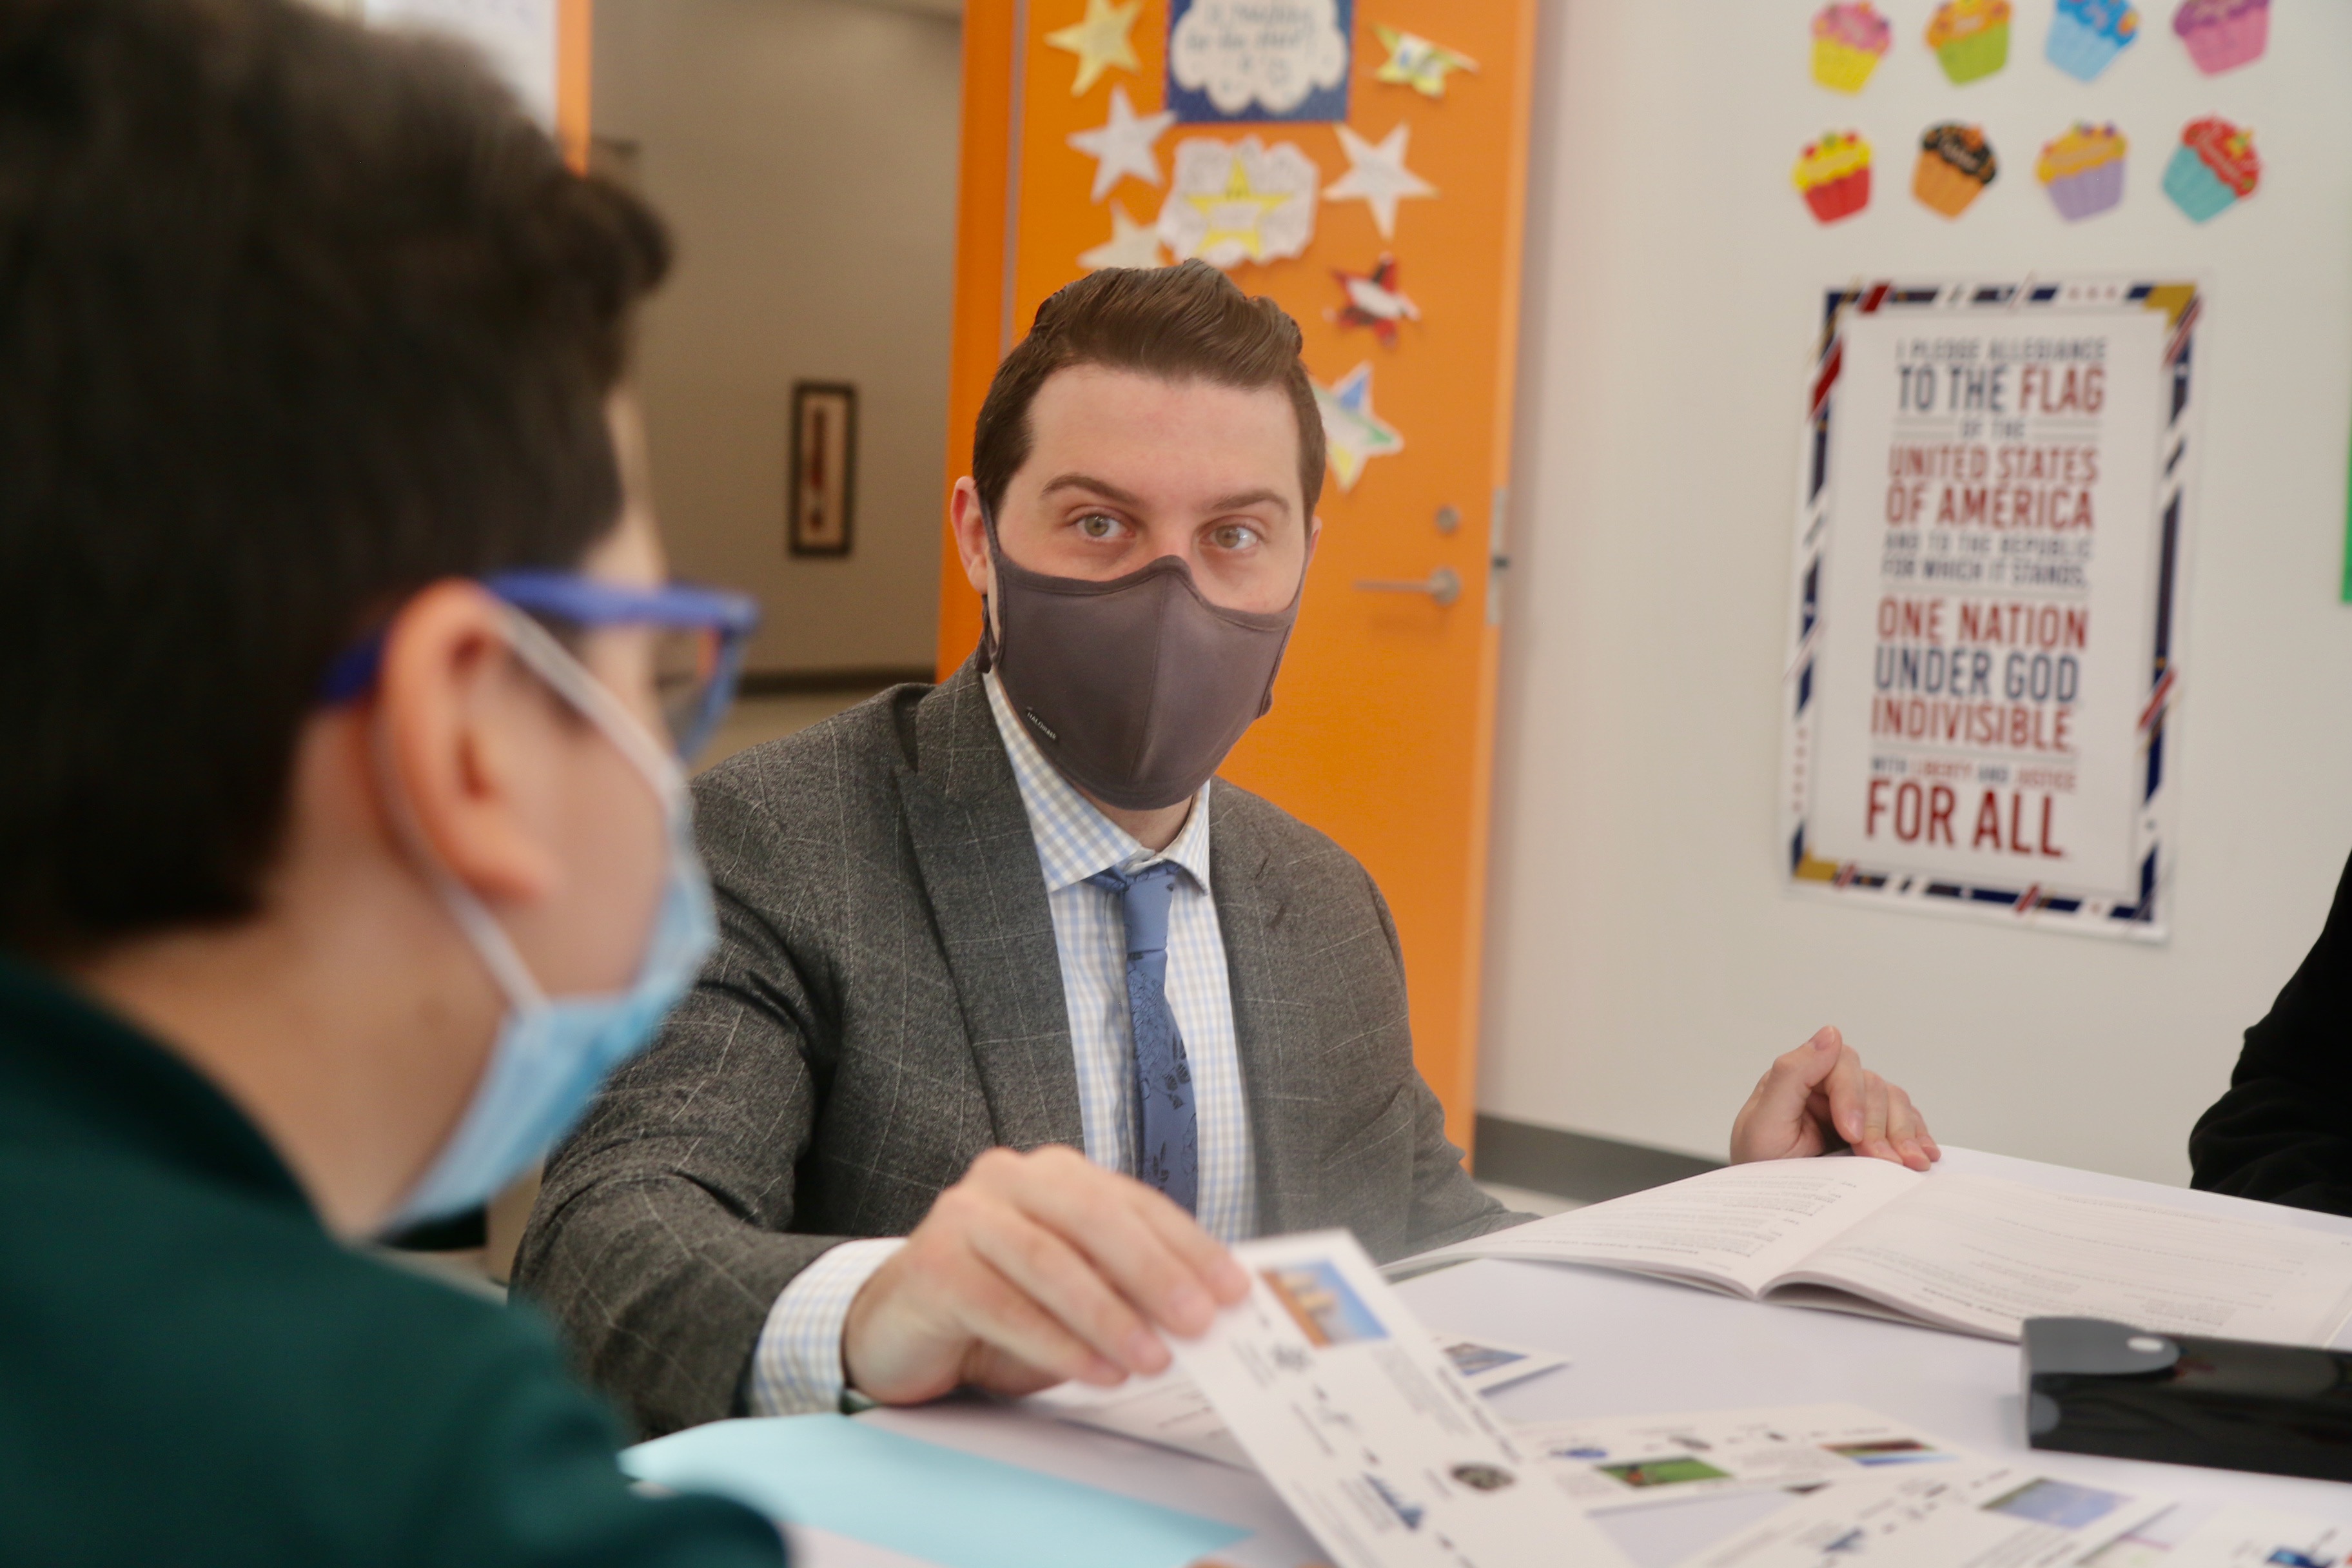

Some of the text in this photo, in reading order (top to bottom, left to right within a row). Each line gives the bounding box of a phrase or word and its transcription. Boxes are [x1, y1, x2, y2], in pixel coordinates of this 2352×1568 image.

[1910, 337, 1980, 360] PLEDGE
[1988, 336, 2108, 362] ALLEGIANCE
[1898, 362, 2106, 414] TO THE FLAG
[1961, 420, 2025, 440] OF THE
[1888, 444, 2099, 482] UNITED STATES
[1885, 482, 2093, 531] OF AMERICA
[1885, 531, 2093, 558] AND TO THE REPUBLIC
[1882, 557, 1916, 578] FOR
[1922, 559, 1983, 580] WHICH
[1990, 561, 2007, 582] IT
[1877, 596, 2090, 651] ONE NATION
[1874, 643, 2080, 704] UNDER GOD
[1872, 755, 2078, 794] WITH LIBERTY AND JUSTICE
[1866, 778, 2066, 859] FOR ALL
